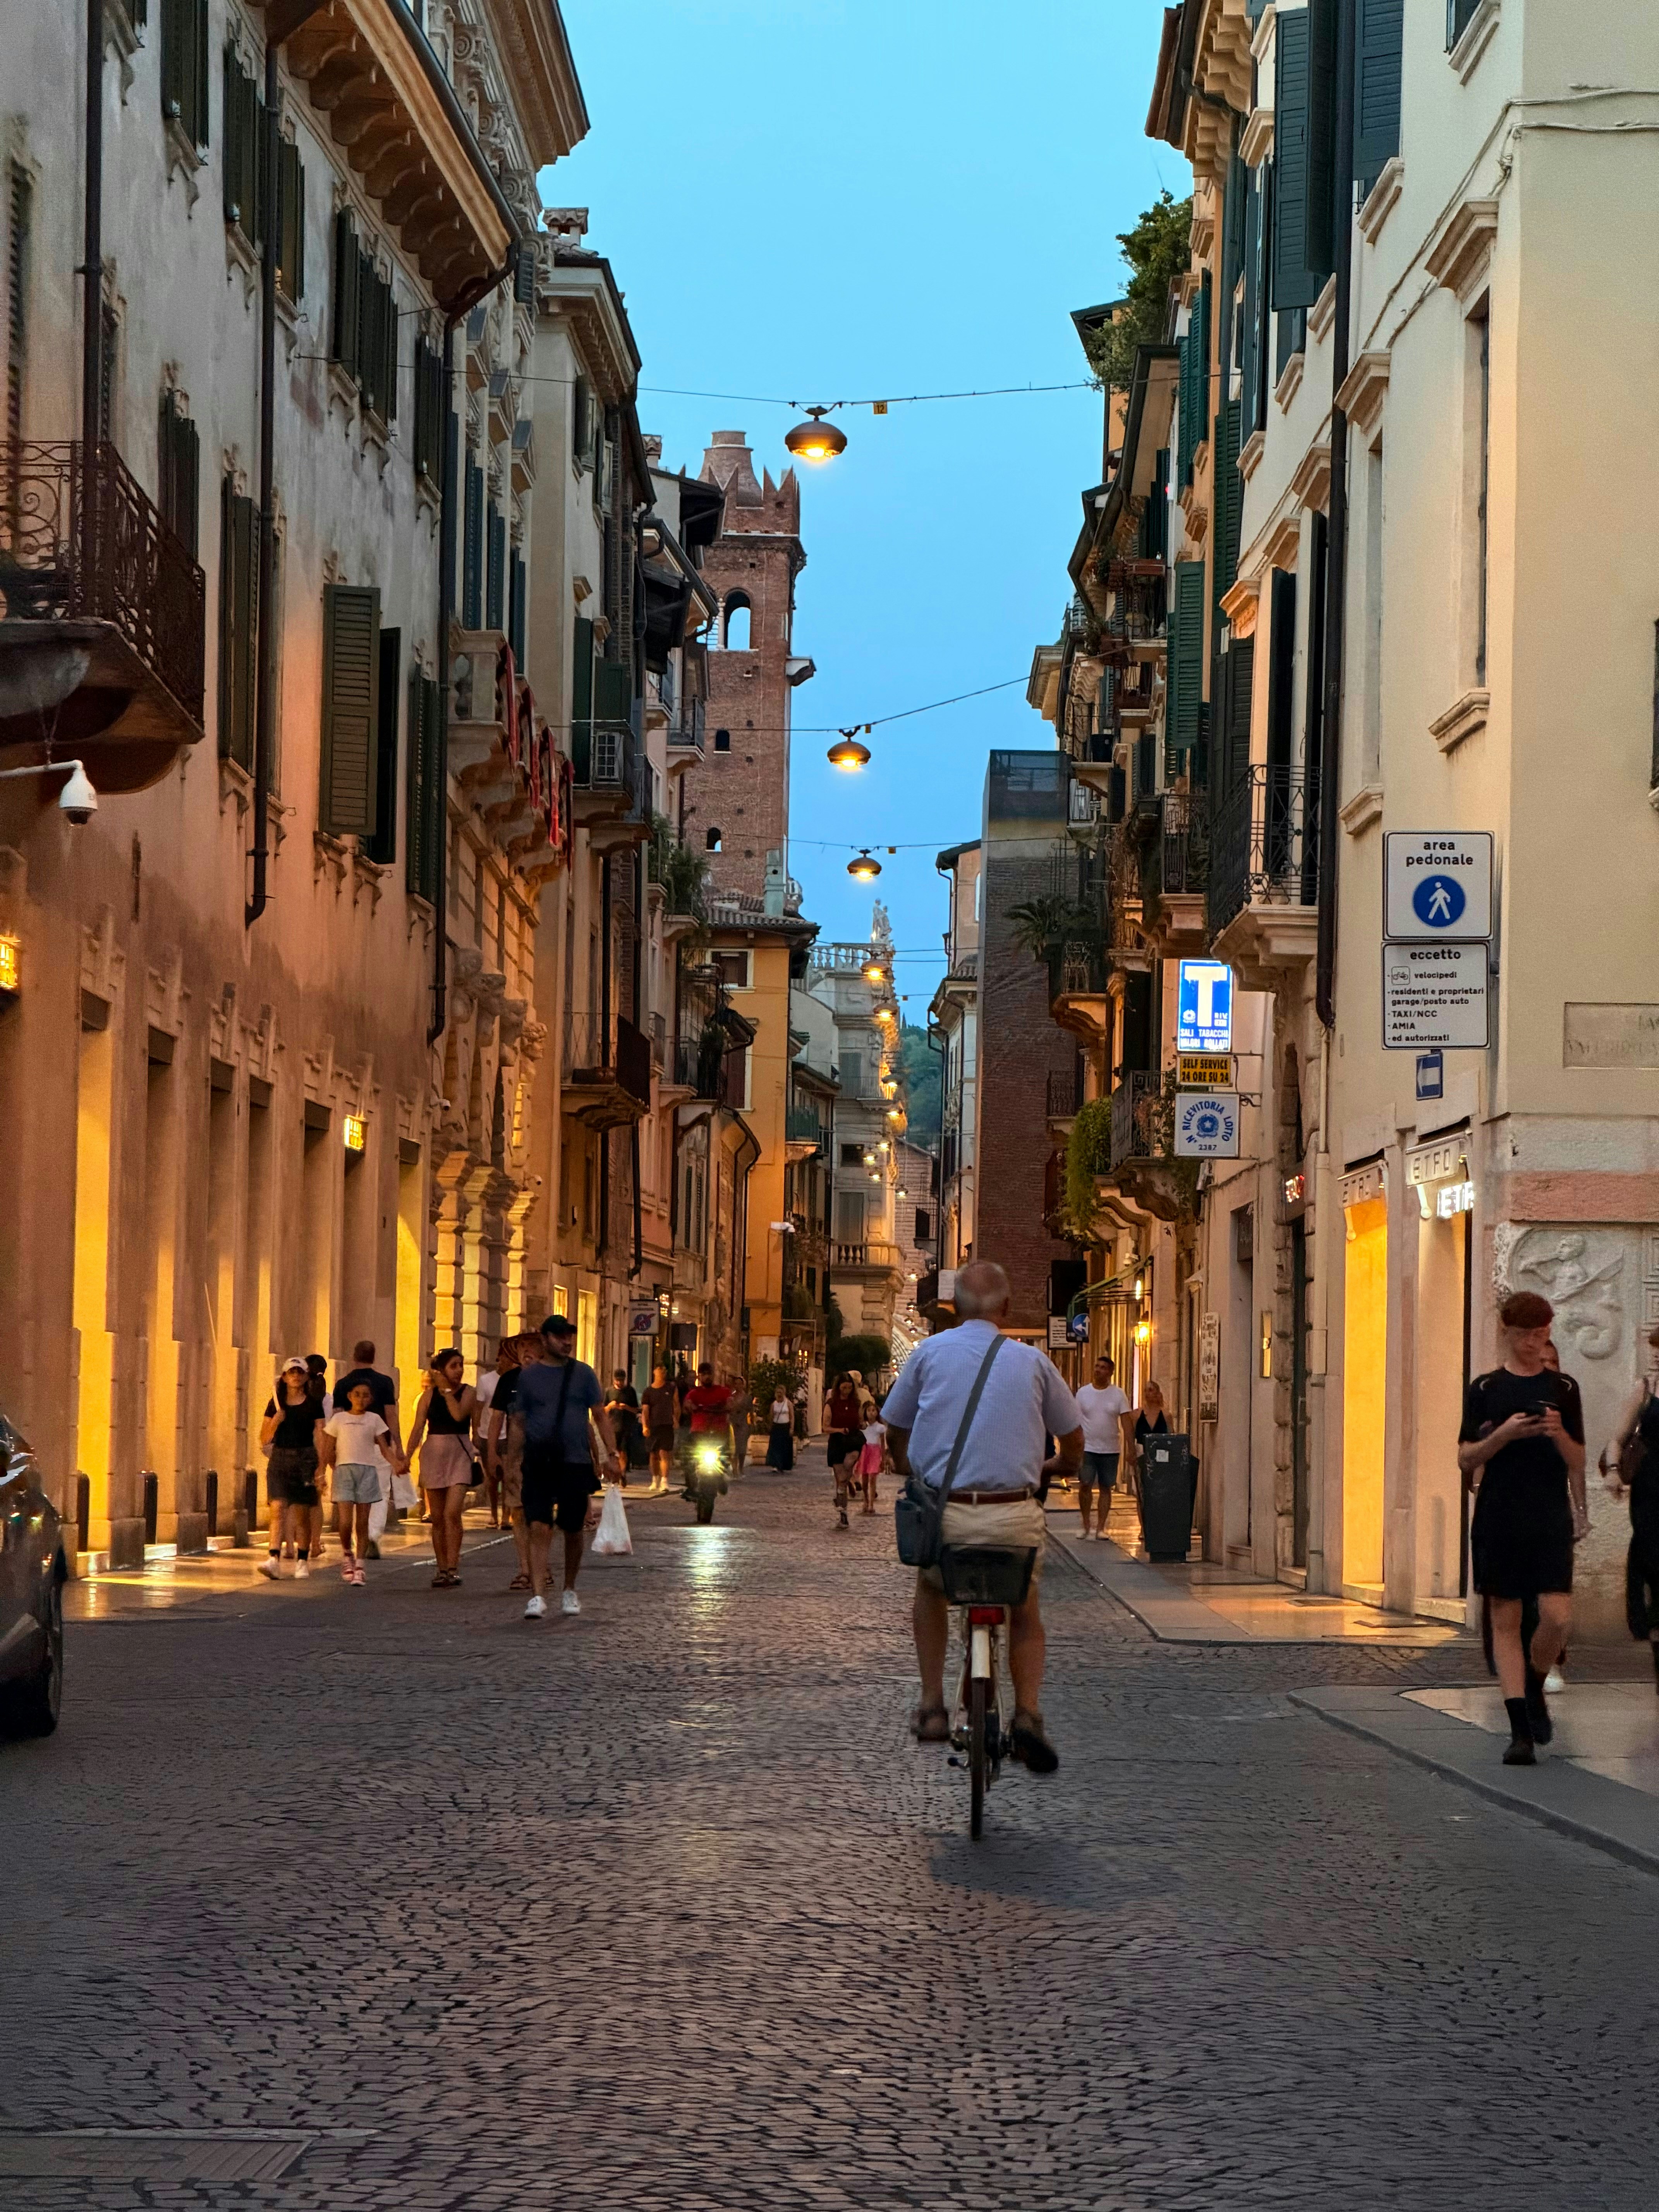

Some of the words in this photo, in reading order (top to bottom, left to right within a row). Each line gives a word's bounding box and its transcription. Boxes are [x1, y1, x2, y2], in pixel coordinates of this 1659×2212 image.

[1424, 842, 1455, 850] area
[1406, 854, 1474, 867] pedonale
[1410, 949, 1461, 960] eccetto
[1185, 966, 1227, 1027] T
[1180, 1028, 1194, 1037] SALI
[1199, 1029, 1228, 1037] TABACCHI
[1183, 1058, 1197, 1068] SELF
[1200, 1059, 1228, 1069] SERVICE
[1182, 1071, 1190, 1081] 24
[1192, 1072, 1207, 1082] ORE
[1209, 1072, 1218, 1082] SU
[1220, 1072, 1228, 1082] 24
[1182, 1101, 1224, 1130] RICEVITORIA
[1221, 1116, 1233, 1142] LOTTO
